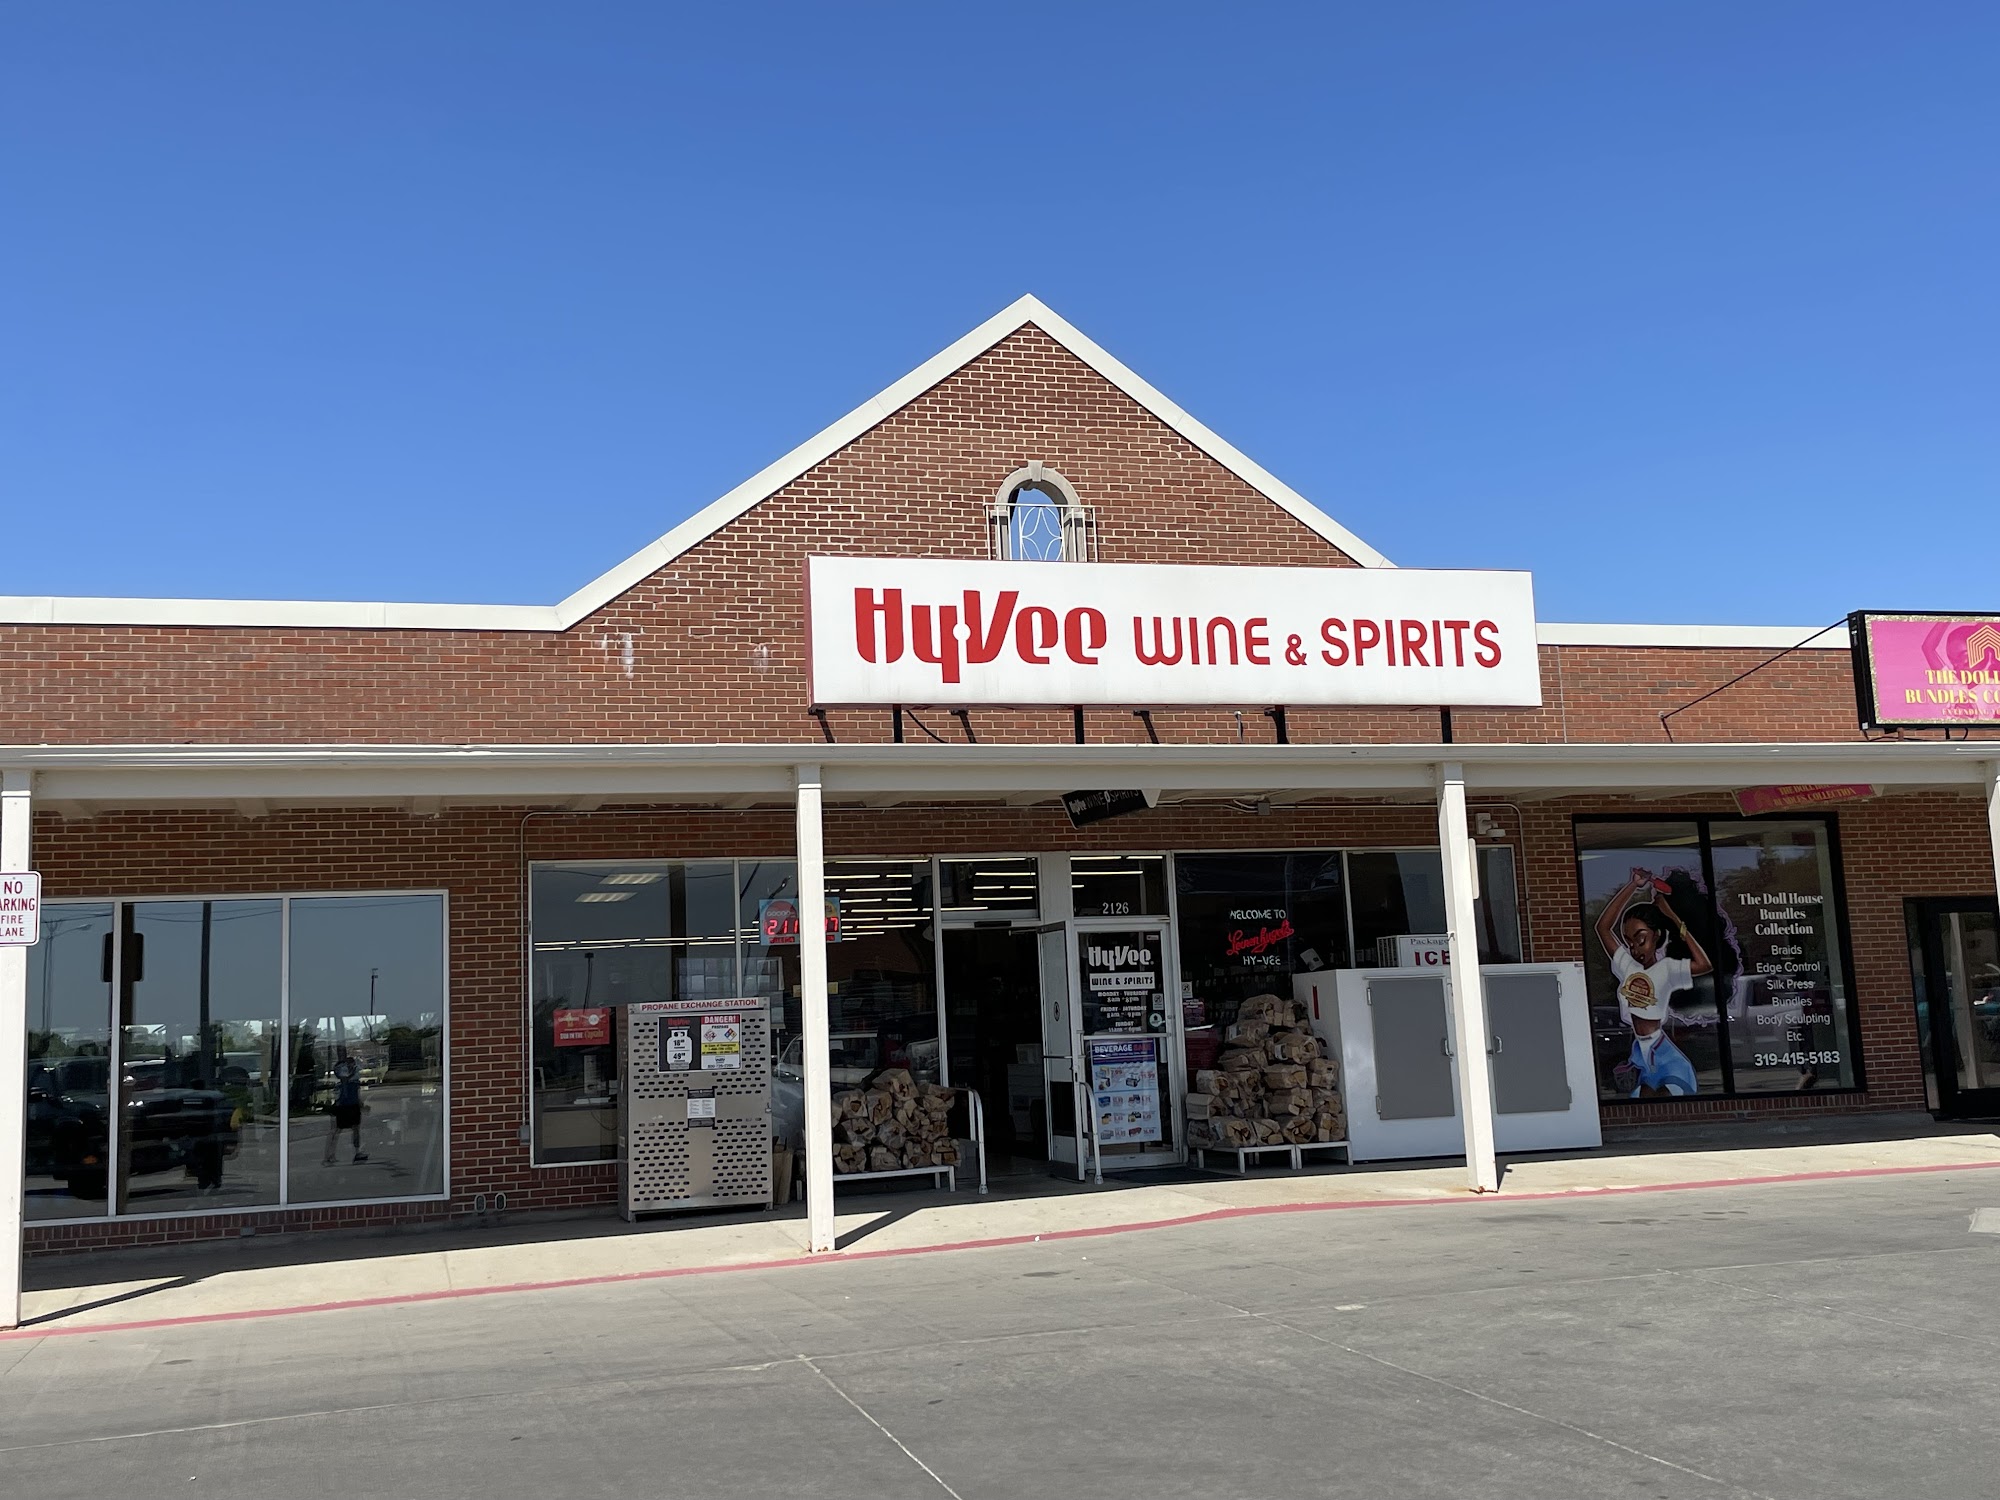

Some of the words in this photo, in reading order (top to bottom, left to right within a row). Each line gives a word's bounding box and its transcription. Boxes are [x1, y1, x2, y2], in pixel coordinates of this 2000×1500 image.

[1133, 615, 1270, 666] WINE
[1285, 633, 1307, 666] &
[1321, 617, 1502, 668] SPIRITS
[1925, 669, 1958, 685] THE
[1905, 688, 1978, 704] BUNDLES
[1807, 787, 1857, 801] COLLECTION
[4, 880, 23, 895] NO
[1738, 893, 1762, 905] The
[1763, 892, 1788, 905] Doll
[1788, 892, 1823, 904] House
[1102, 902, 1129, 915] 2126
[1229, 909, 1272, 920] WELCOME
[1274, 909, 1287, 919] TO
[1759, 907, 1806, 921] Bundles
[1, 915, 24, 924] FIRE
[0, 927, 24, 937] LANE
[1755, 922, 1814, 936] Collection
[1771, 944, 1802, 955] Braids
[1242, 955, 1281, 965] HY-VEE
[1414, 949, 1451, 966] ICE
[1756, 962, 1782, 975] Edge
[1785, 961, 1821, 972] Control
[1091, 977, 1112, 986] WINE
[1115, 977, 1121, 985] &
[1123, 976, 1153, 985] SPIRITS
[1766, 979, 1785, 990] Silk
[1787, 979, 1815, 990] Press
[641, 1002, 679, 1011] PROPANE
[680, 1000, 723, 1009] EXCHANGE
[724, 999, 757, 1007] STATION
[1771, 996, 1812, 1007] Bundles
[704, 1015, 736, 1023] DANGER!
[1757, 1015, 1783, 1026] Body
[1785, 1013, 1830, 1026] Sculpting
[1786, 1031, 1805, 1042] Etc.
[1094, 1043, 1133, 1053] BEVERAGE
[1754, 1051, 1841, 1066] 319-415-5183
